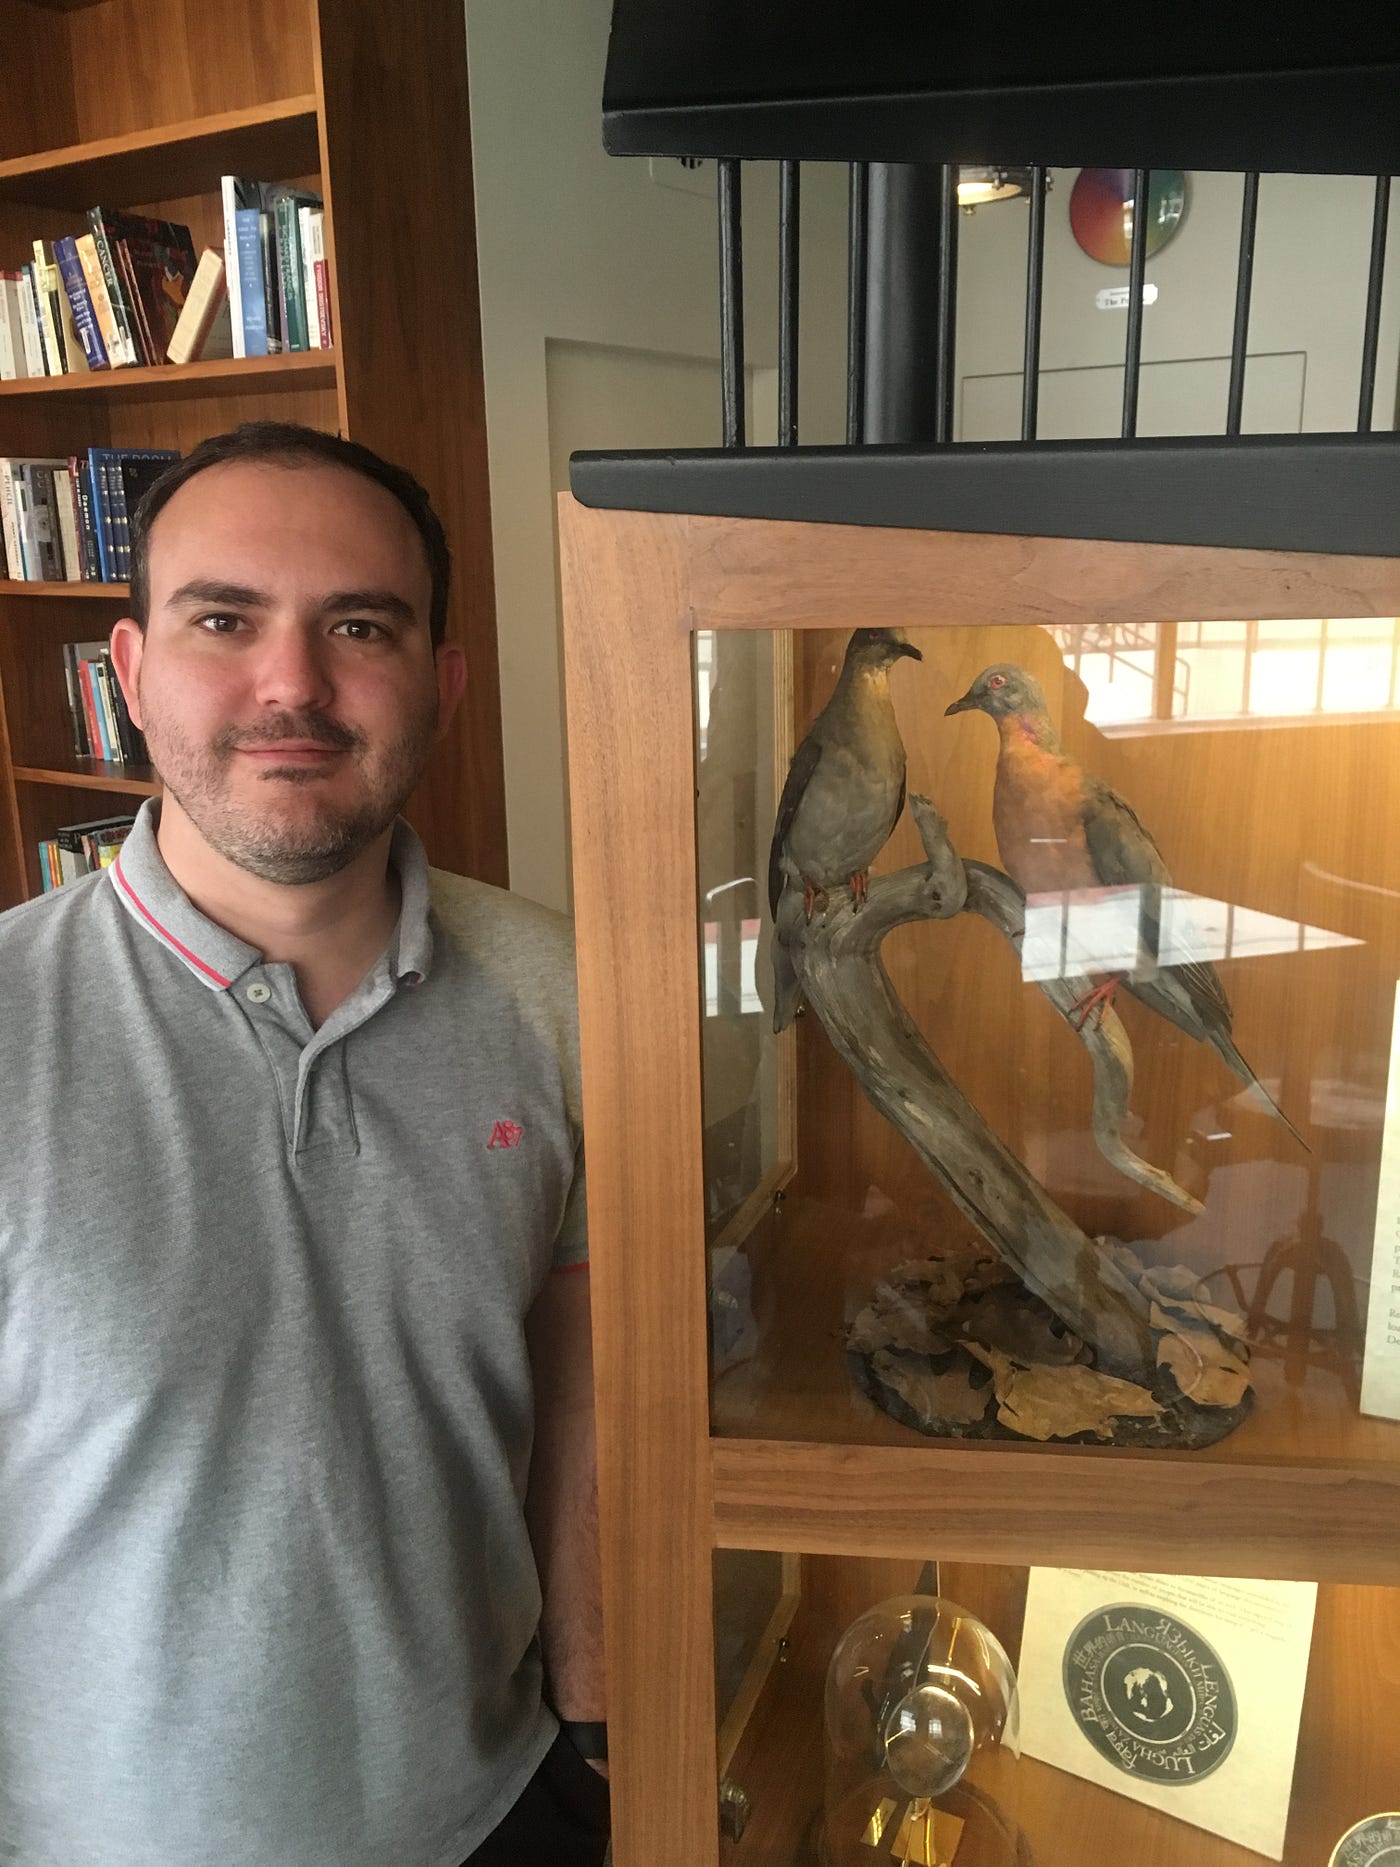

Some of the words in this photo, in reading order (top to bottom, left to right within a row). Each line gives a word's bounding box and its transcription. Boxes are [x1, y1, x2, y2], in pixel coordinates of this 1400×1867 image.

[97, 240, 113, 287] CANCER
[82, 494, 91, 531] Daemon
[1132, 1739, 1197, 1775] LUGHA
